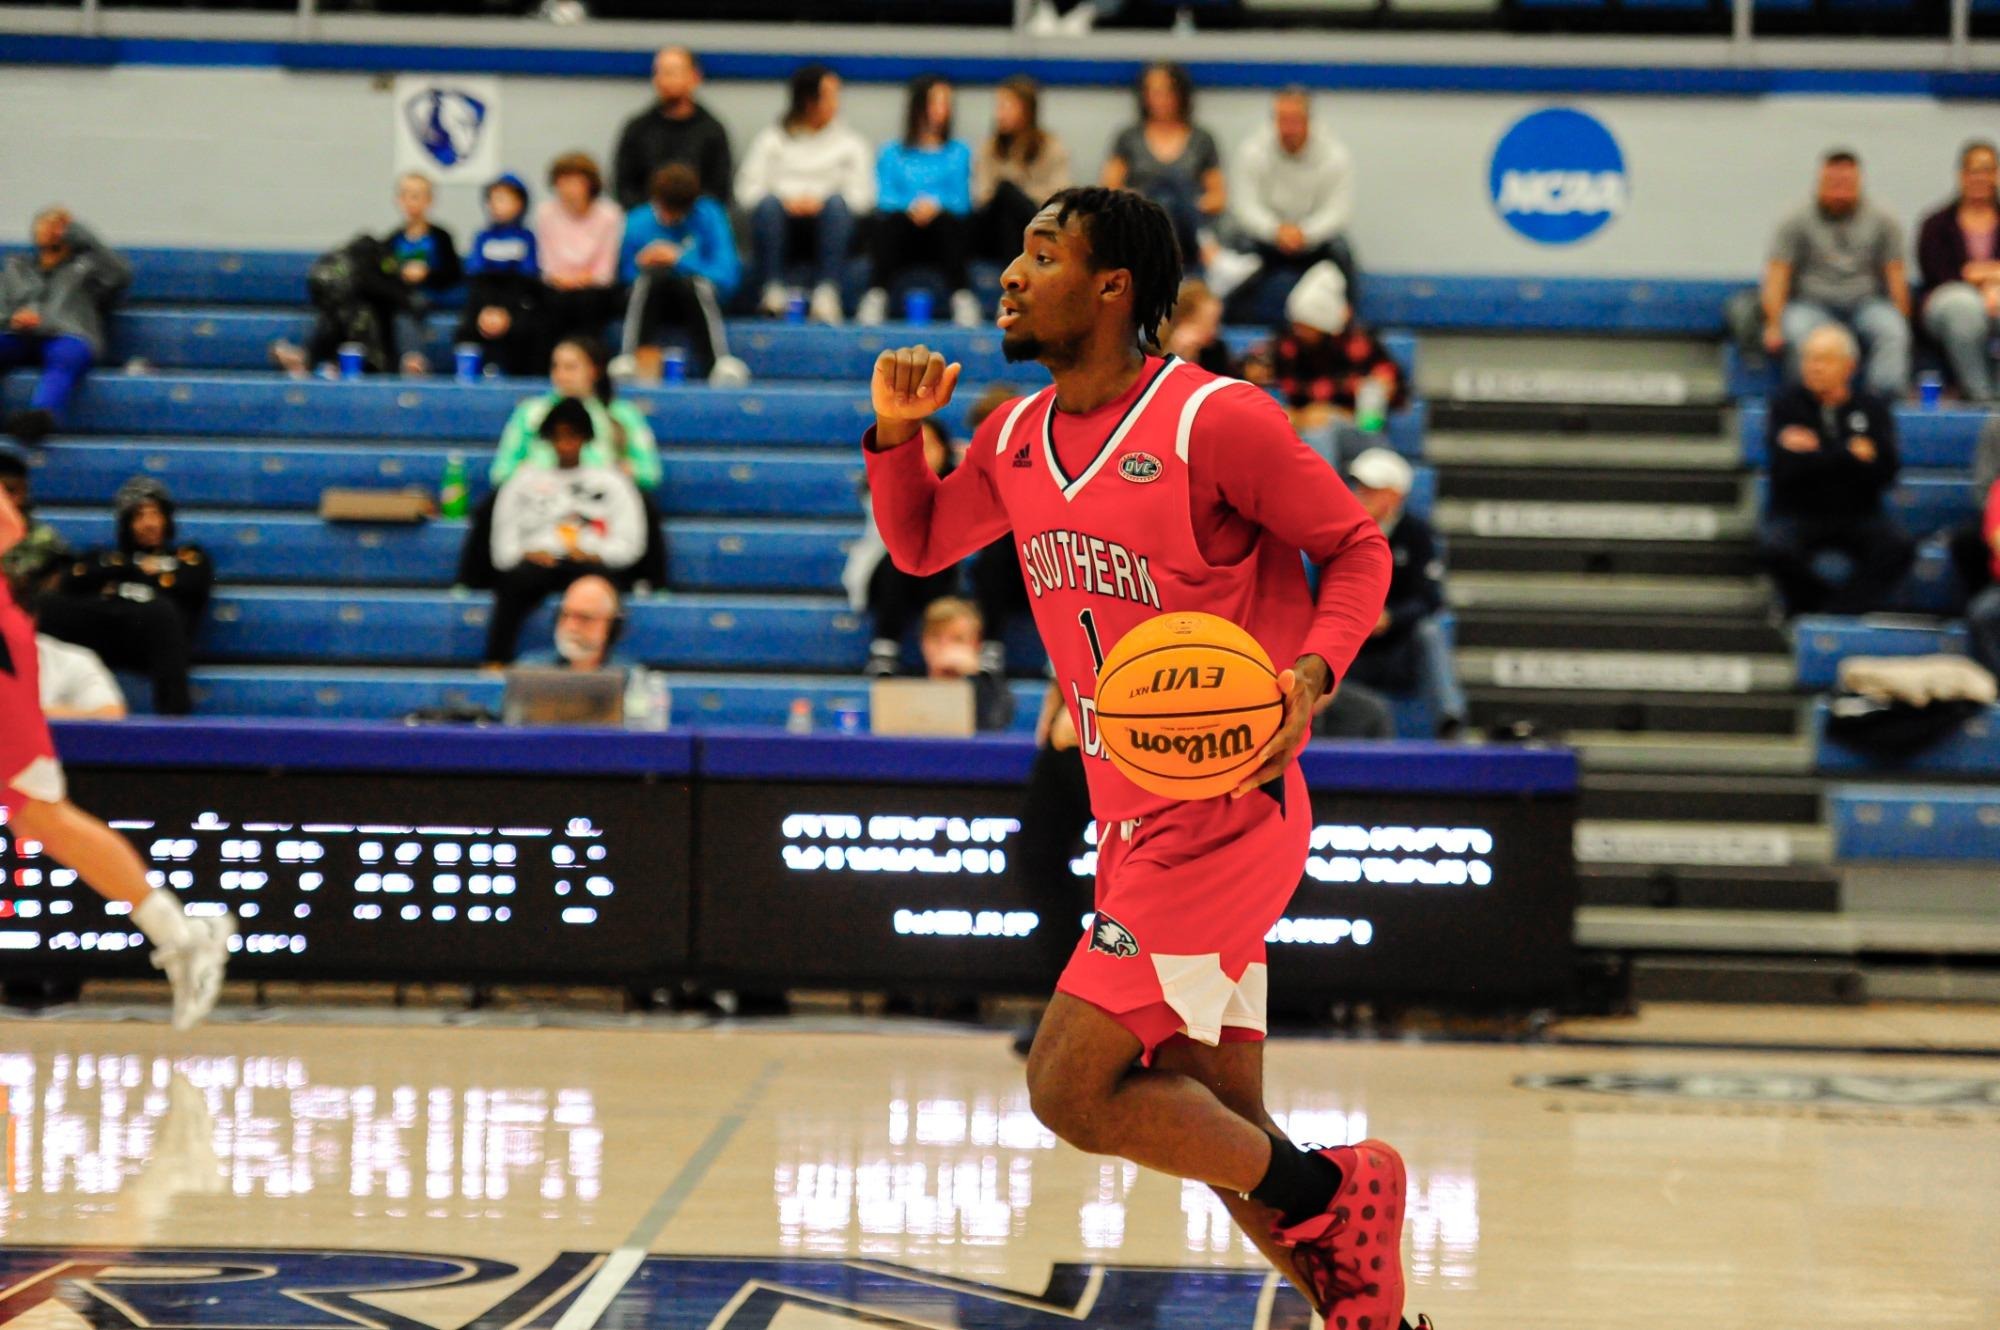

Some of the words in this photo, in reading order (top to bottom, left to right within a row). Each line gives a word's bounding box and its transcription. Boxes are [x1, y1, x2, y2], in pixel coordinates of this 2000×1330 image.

[1022, 529, 1162, 610] SOUTHERN
[1078, 608, 1104, 678] 1
[1129, 685, 1149, 699] NXT
[1151, 666, 1225, 692] EVO
[1129, 723, 1255, 764] Wilson
